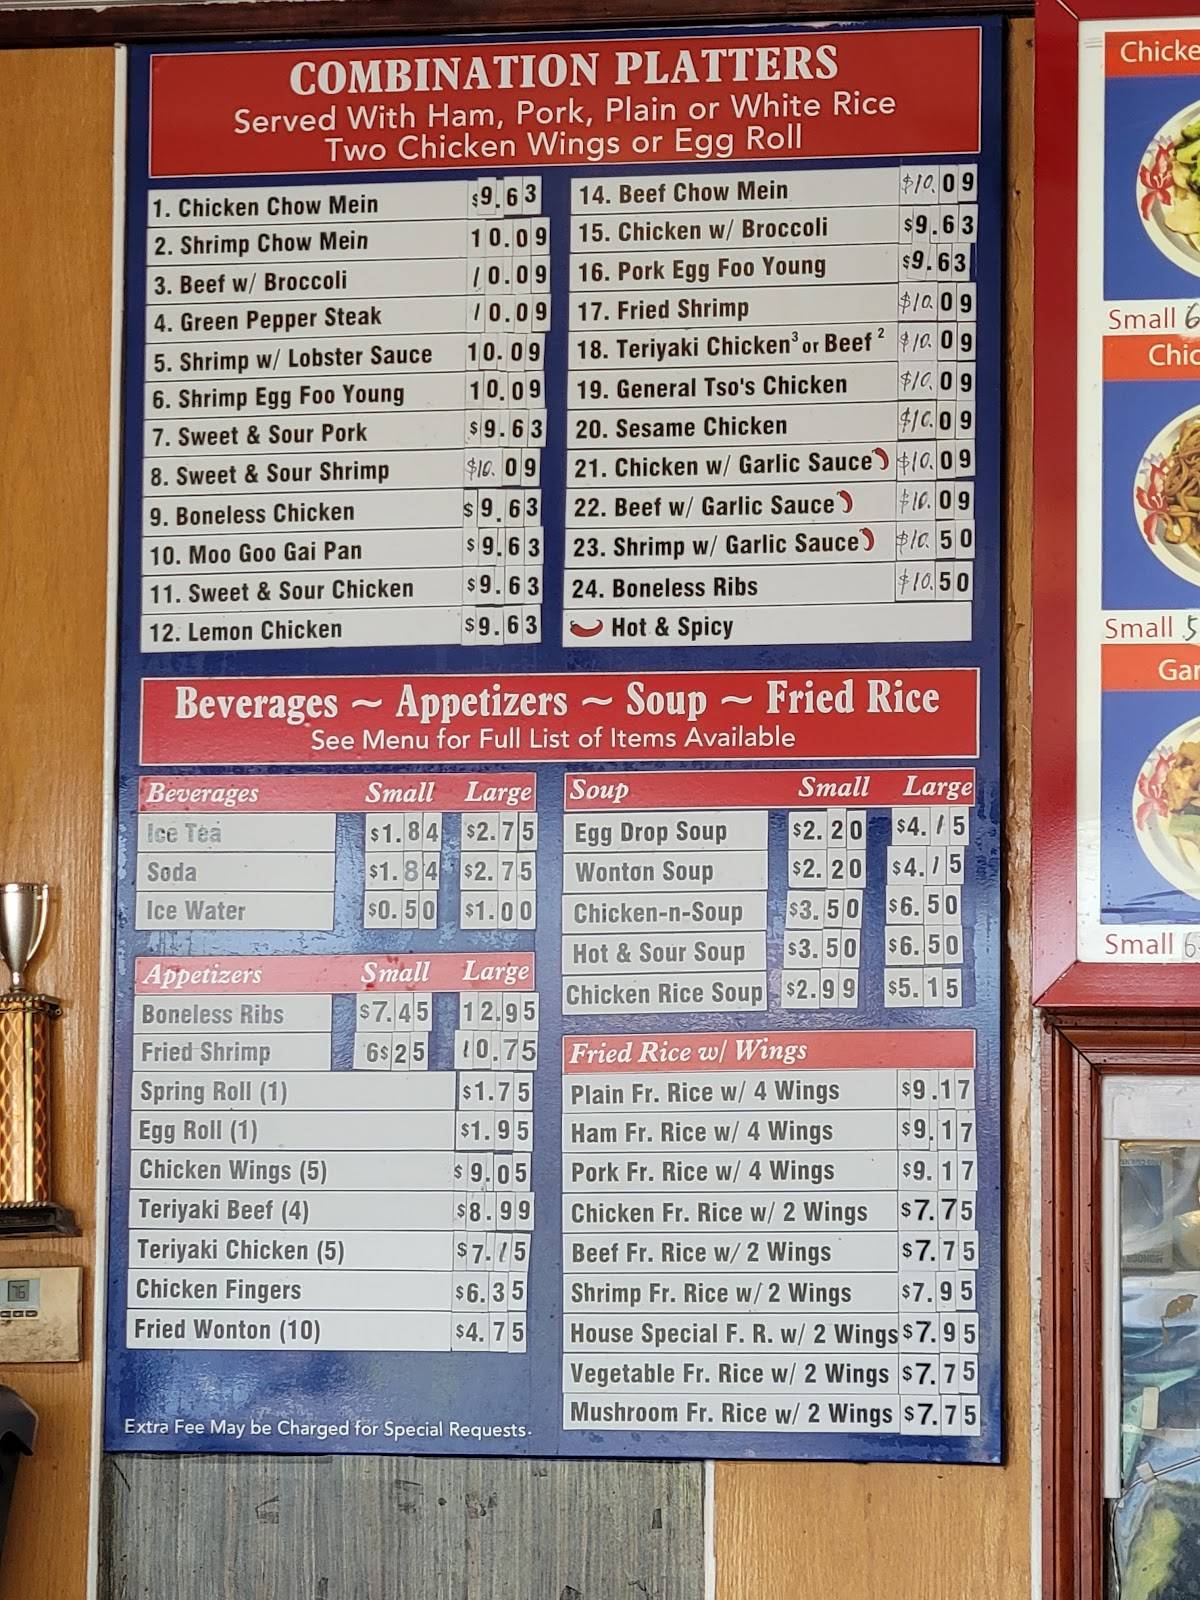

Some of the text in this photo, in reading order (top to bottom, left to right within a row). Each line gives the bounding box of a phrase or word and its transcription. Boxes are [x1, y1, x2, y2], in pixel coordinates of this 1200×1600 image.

[291, 45, 837, 95] COMBINATION PLATTERS
[235, 91, 895, 133] Served With Ham, Pork, Plain or White Rice
[325, 123, 800, 161] Two Chicken Wings or Egg Roll
[154, 184, 536, 217] 1. Chicken Chow Mein $9.63
[579, 214, 973, 242] 15. Chicken w/ Broccoli $9.63
[155, 227, 546, 257] 2. Shrimp Chow Mein 10.09
[578, 302, 609, 321] 17.
[618, 300, 669, 320] Fried
[678, 298, 748, 321] Shrimp
[1109, 307, 1175, 329] Small
[153, 419, 542, 446] 7. Sweet & Sour Pork $9.63
[151, 496, 537, 526] 9. Boneless Chicken $9.63
[573, 580, 603, 598] 24.
[613, 578, 705, 597] Boneless
[714, 577, 757, 596] Ribs
[150, 615, 537, 642] 12. Lemon Chicken $9.63
[613, 616, 733, 641] Hot & Spicy
[1105, 616, 1171, 639] Small
[175, 679, 939, 726] Beverages Appetizers Soup Fried Rice
[312, 725, 795, 750] See Menu for Full List of Items Available
[146, 782, 531, 805] Beverages Small Large
[570, 776, 972, 803] Soup Small Large
[576, 820, 862, 846] Egg Drop Soup $2.20
[148, 859, 531, 881] Soda $1.84 $2.75
[148, 900, 531, 921] Ice Water $0.50 $1.00
[575, 894, 957, 926] Chicken-n-Soup $3.50 $6.50
[574, 934, 958, 965] Hot & Sour Soup $3.50 $6.50
[1105, 932, 1172, 954] Small
[143, 960, 529, 989] Appetizers Small Large
[143, 1001, 535, 1024] Boneless Ribs $7.45 12.95
[569, 1040, 807, 1063] Fried Rice w/ Wings
[572, 1079, 969, 1104] Plain Fr. Rice w/ 4 Wings $9.17
[139, 1199, 530, 1224] Teriyaki Beef (4) $8.99
[135, 1319, 523, 1344] Fried Wonton (10) $4.75
[571, 1321, 975, 1348] House Special F. R. w/ 2 Wings $7.95
[126, 1419, 531, 1443] Extra Fee May be Charged for Special Requests.
